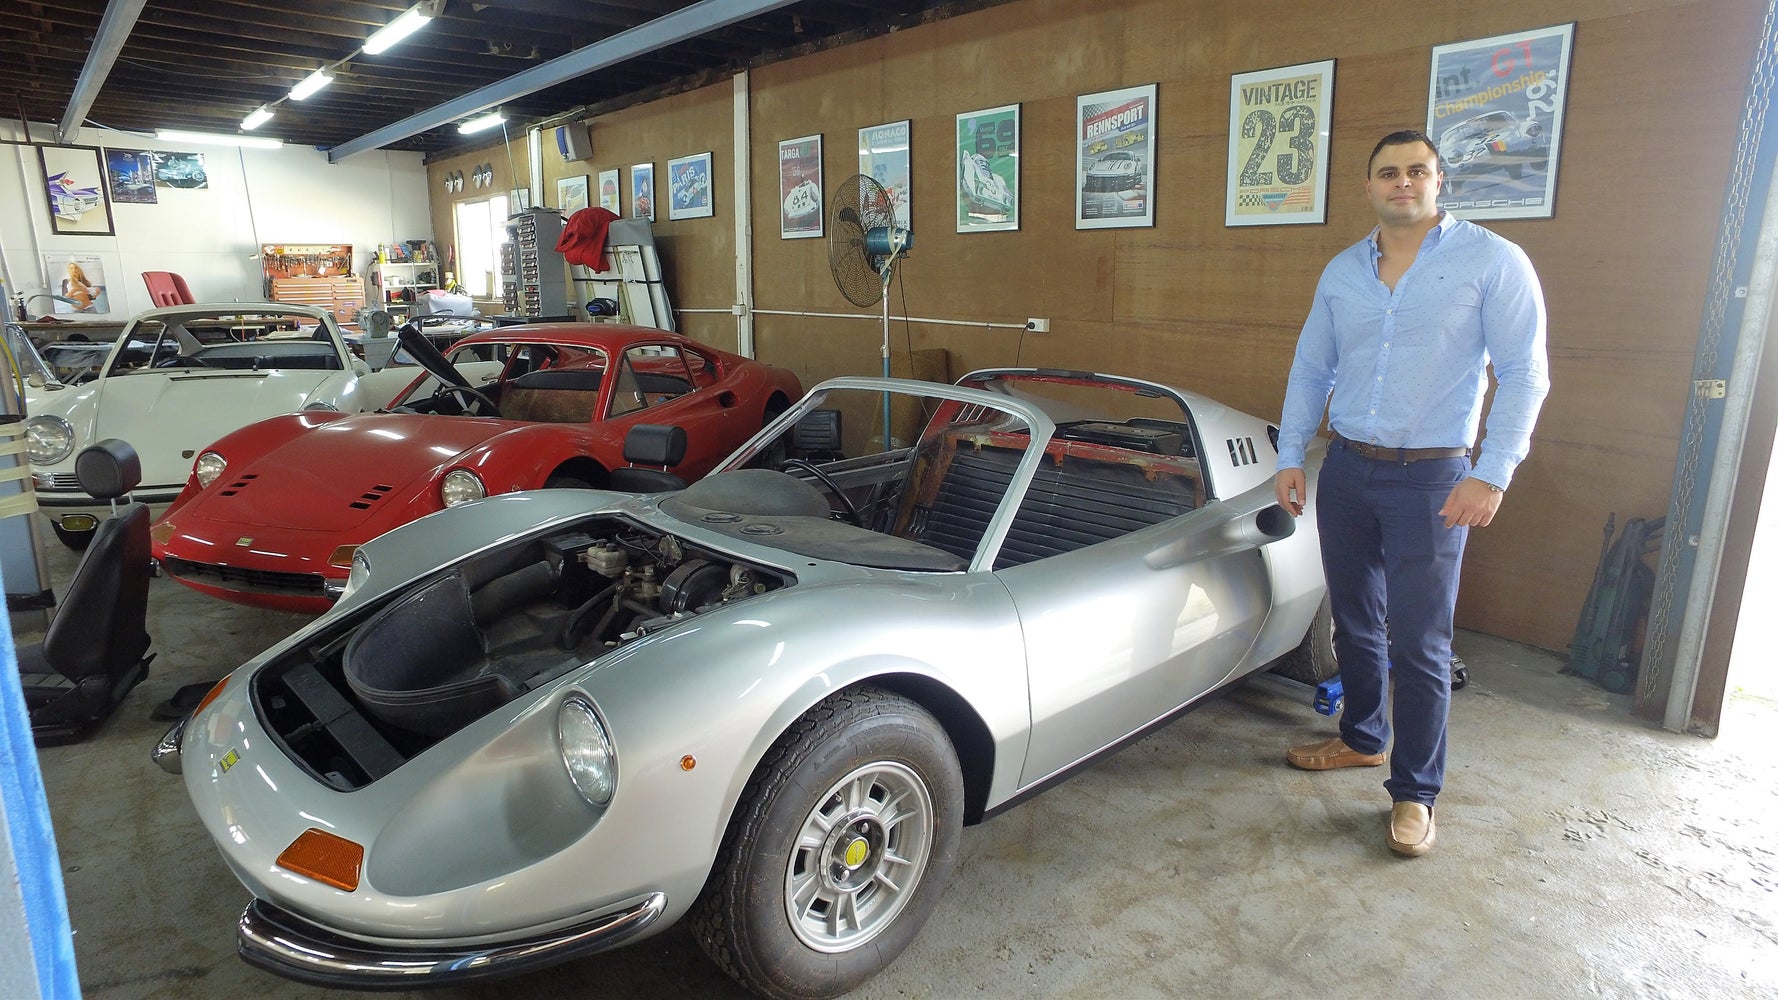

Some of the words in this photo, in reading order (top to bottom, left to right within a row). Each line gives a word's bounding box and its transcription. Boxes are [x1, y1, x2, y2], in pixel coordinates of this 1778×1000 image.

[1490, 39, 1534, 78] GT
[1242, 79, 1318, 106] VINTAGE
[1434, 70, 1546, 118] Championship
[871, 126, 906, 140] MONACO
[1086, 105, 1145, 140] RENNSPORT
[781, 147, 800, 161] TARGA
[1240, 105, 1316, 187] 23
[673, 166, 695, 193] PARIS
[792, 190, 808, 205] 84
[1437, 198, 1544, 209] PORSCHE
